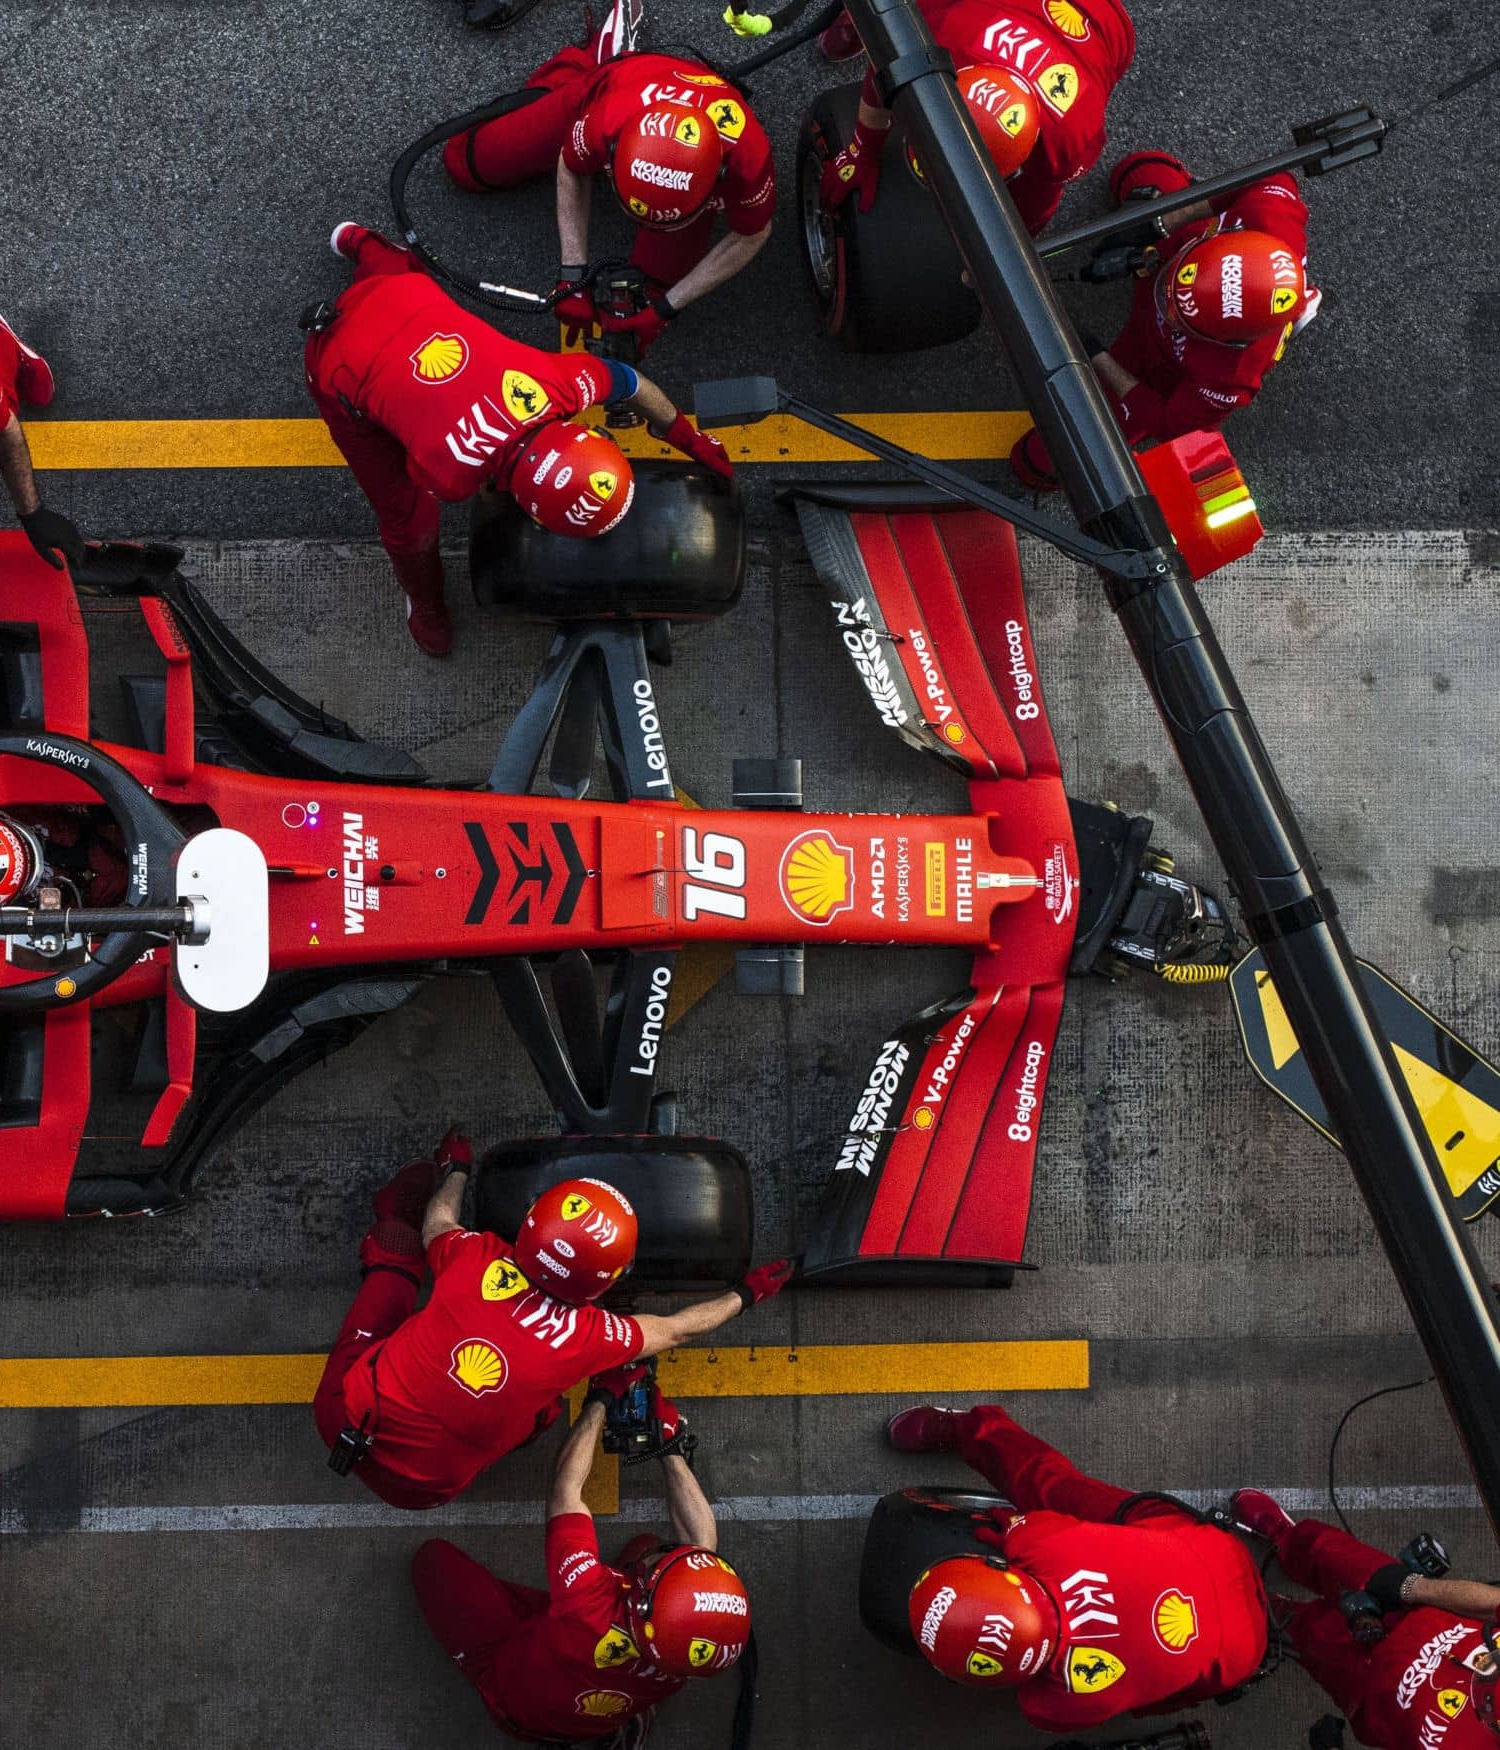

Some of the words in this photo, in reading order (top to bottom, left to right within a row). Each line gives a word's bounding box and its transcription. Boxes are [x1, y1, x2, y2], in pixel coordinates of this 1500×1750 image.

[831, 600, 901, 728] MISSION
[909, 628, 953, 722] V-Power
[1005, 619, 1034, 700] eightcap
[633, 679, 670, 788] Lenovo
[137, 842, 148, 895] WEICHAI
[343, 812, 365, 936] WEICHAI
[681, 825, 747, 922] 16
[871, 859, 885, 919] AMD
[956, 837, 972, 922] MAHLE
[1045, 858, 1054, 895] ACTION
[1054, 844, 1062, 875] SAFETY
[1054, 875, 1062, 897] ROAD
[630, 966, 672, 1076] Lenovo
[923, 1013, 976, 1103] V-Power
[1015, 1040, 1045, 1123] eightcap
[556, 1241, 572, 1256] BELL
[564, 1557, 600, 1588] HUBLOT
